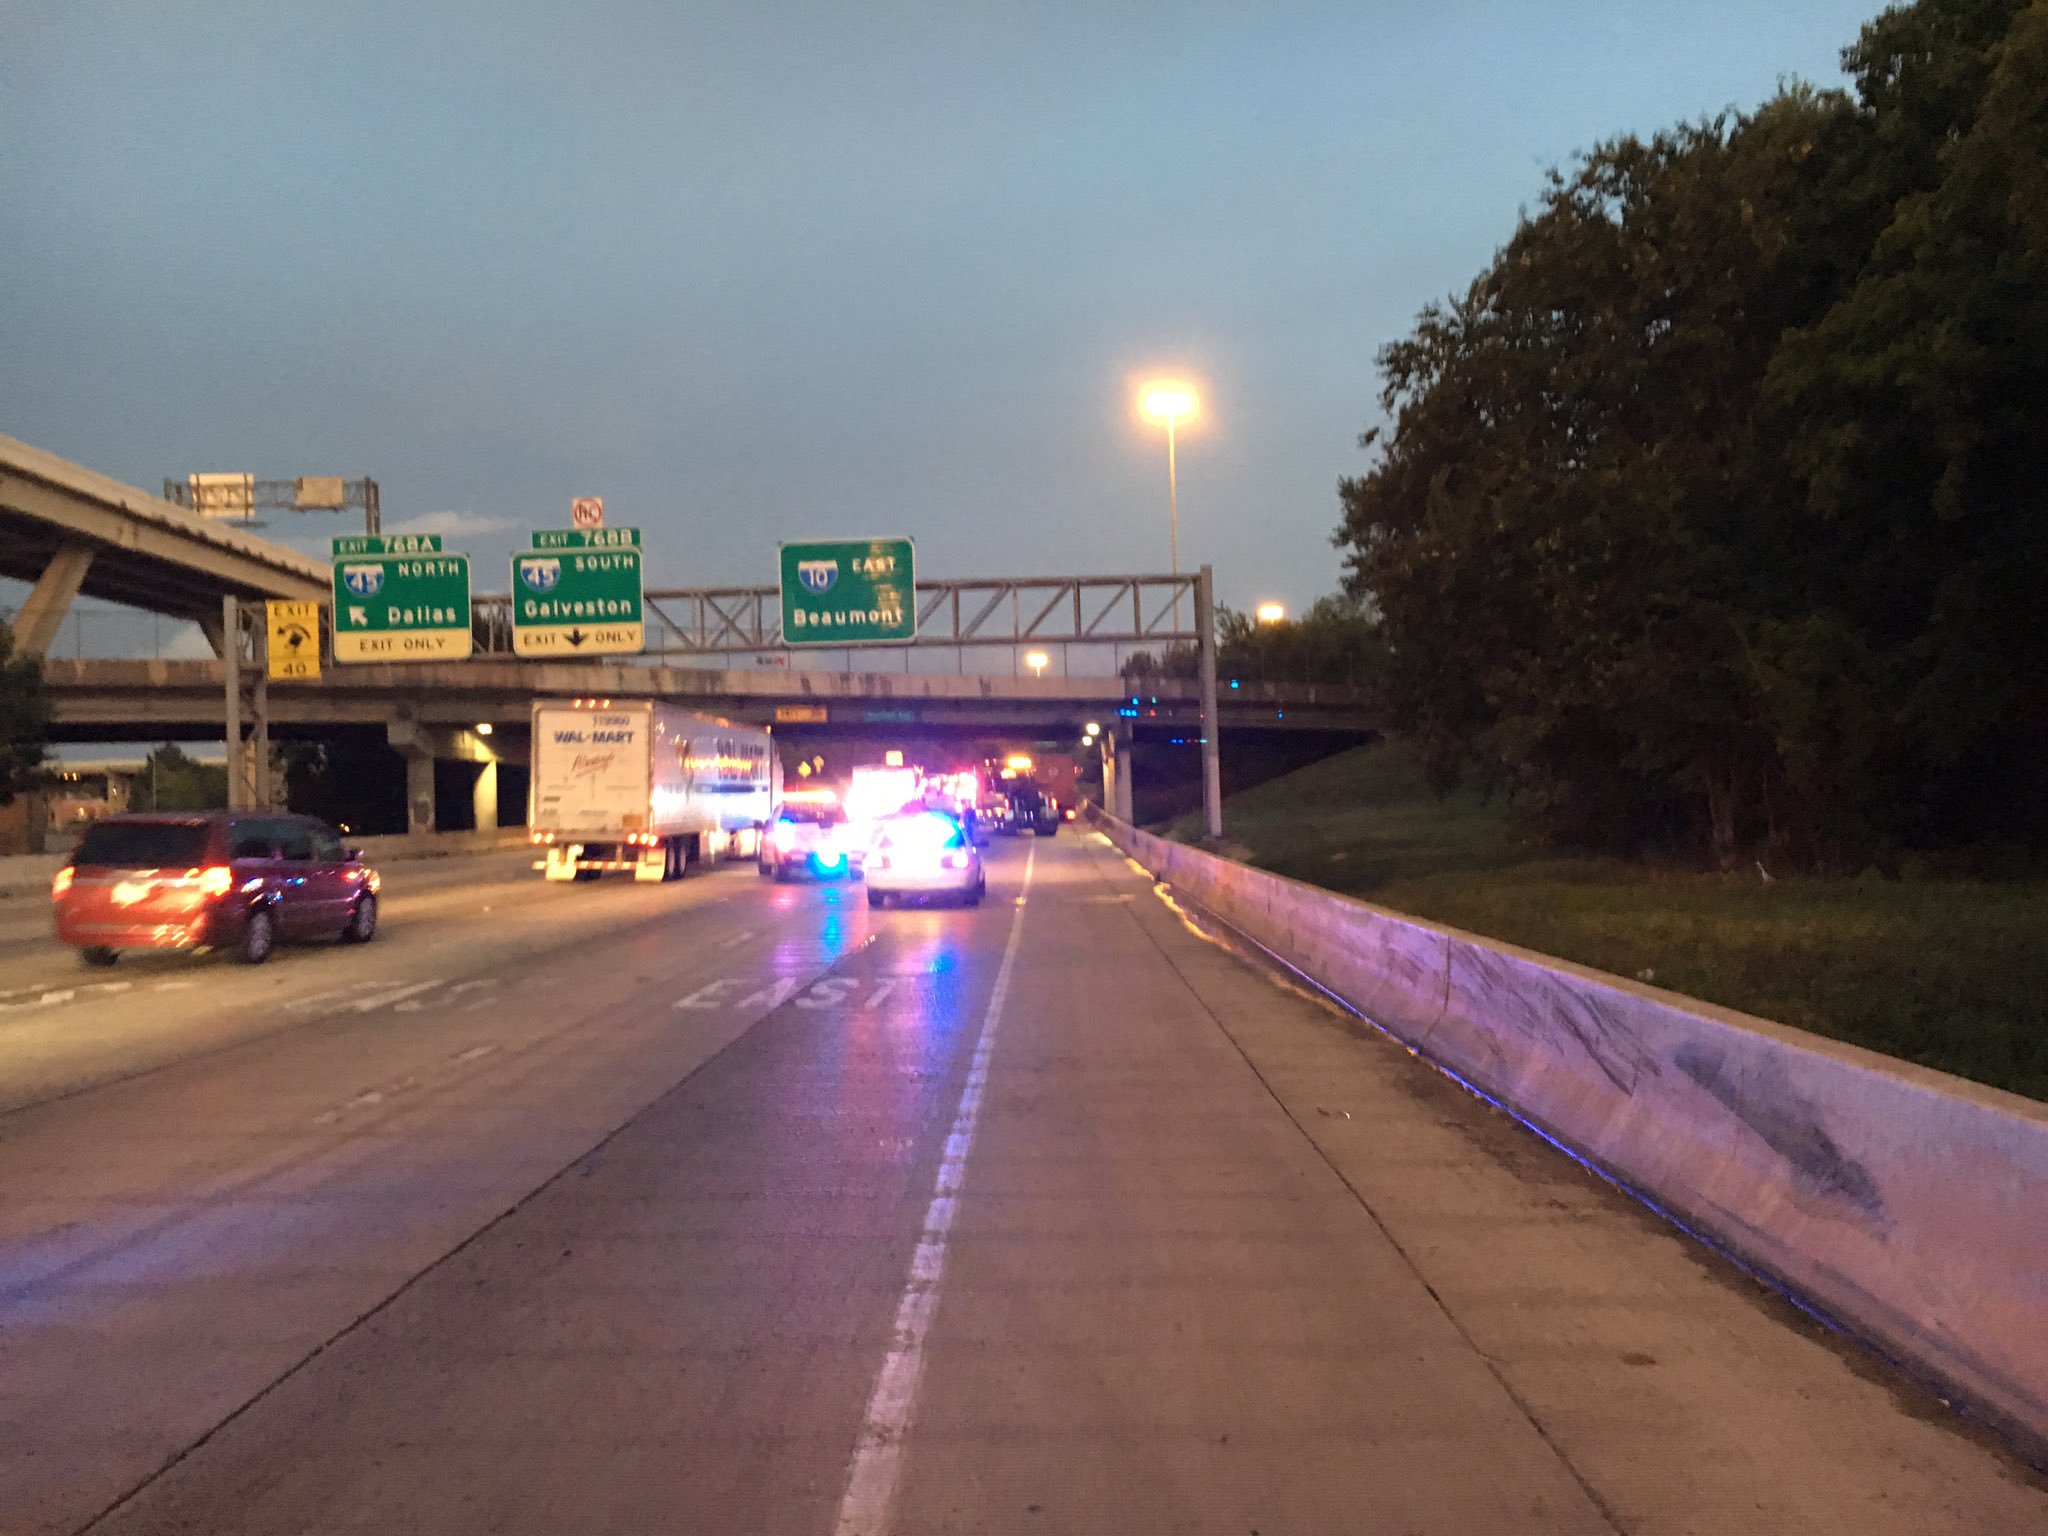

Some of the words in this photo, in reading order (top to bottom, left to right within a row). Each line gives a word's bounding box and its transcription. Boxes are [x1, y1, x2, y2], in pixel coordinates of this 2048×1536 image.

[398, 561, 459, 576] NORTH
[575, 555, 633, 571] SOUTH
[852, 556, 896, 573] EAST
[809, 568, 828, 587] 10
[273, 603, 310, 617] EXIT
[388, 605, 456, 625] Dallas
[524, 599, 632, 618] Galveston
[793, 607, 903, 627] Beaumont
[360, 639, 393, 651] EXIT
[403, 638, 446, 650] ONLY
[524, 633, 557, 647] EXIT
[595, 631, 637, 643] ONLY
[283, 662, 307, 676] 40
